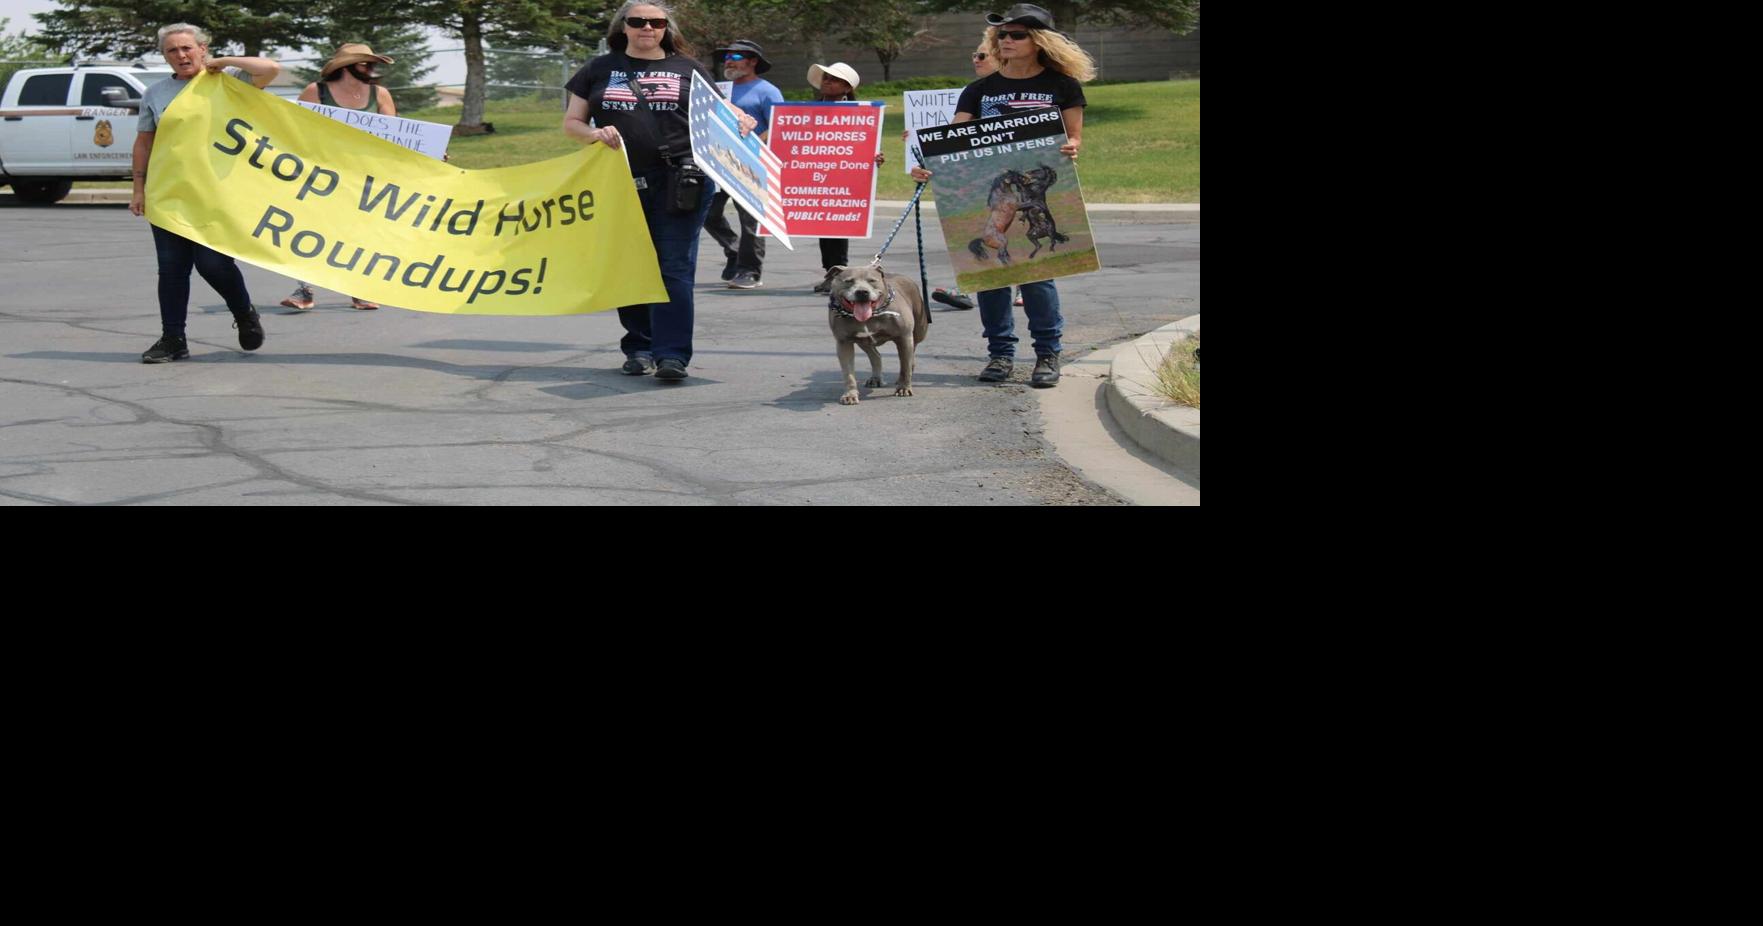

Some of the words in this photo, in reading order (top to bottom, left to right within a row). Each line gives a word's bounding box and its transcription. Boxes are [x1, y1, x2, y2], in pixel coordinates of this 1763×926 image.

[610, 70, 645, 78] BON
[649, 71, 682, 80] FREE
[908, 93, 956, 107] WHITE
[981, 93, 1016, 102] BORN
[1020, 92, 1053, 103] FREE
[601, 101, 638, 111] STAY
[84, 108, 127, 116] RANGER
[312, 105, 337, 118] HY
[345, 111, 389, 130] DOES
[398, 119, 425, 136] THE
[777, 115, 810, 125] STOP
[815, 115, 875, 126] BLAMING
[911, 110, 950, 128] HMA
[919, 132, 943, 143] WE
[947, 126, 977, 139] ARE
[979, 111, 1060, 133] WARRIORS
[781, 131, 813, 141] WILD
[816, 131, 867, 141] HORSES
[970, 132, 1015, 147] DON'T
[790, 145, 799, 155] &
[801, 145, 854, 155] BURROS
[940, 151, 969, 164] PUT
[973, 147, 994, 158] US
[997, 144, 1012, 154] IN
[1016, 137, 1055, 150] PENS
[89, 152, 133, 160] ENFORCEMEN
[791, 159, 836, 171] Damage
[839, 160, 870, 170] Done
[213, 117, 339, 201] Stop
[358, 175, 484, 236] Wild
[813, 172, 827, 183] By
[784, 186, 851, 195] COMMERCIAL
[782, 198, 819, 207] ESTOCK
[821, 198, 867, 208] GRAZING
[787, 211, 824, 221] PUBLIC
[826, 212, 861, 222] Lands!
[251, 205, 548, 304] Roundups!
